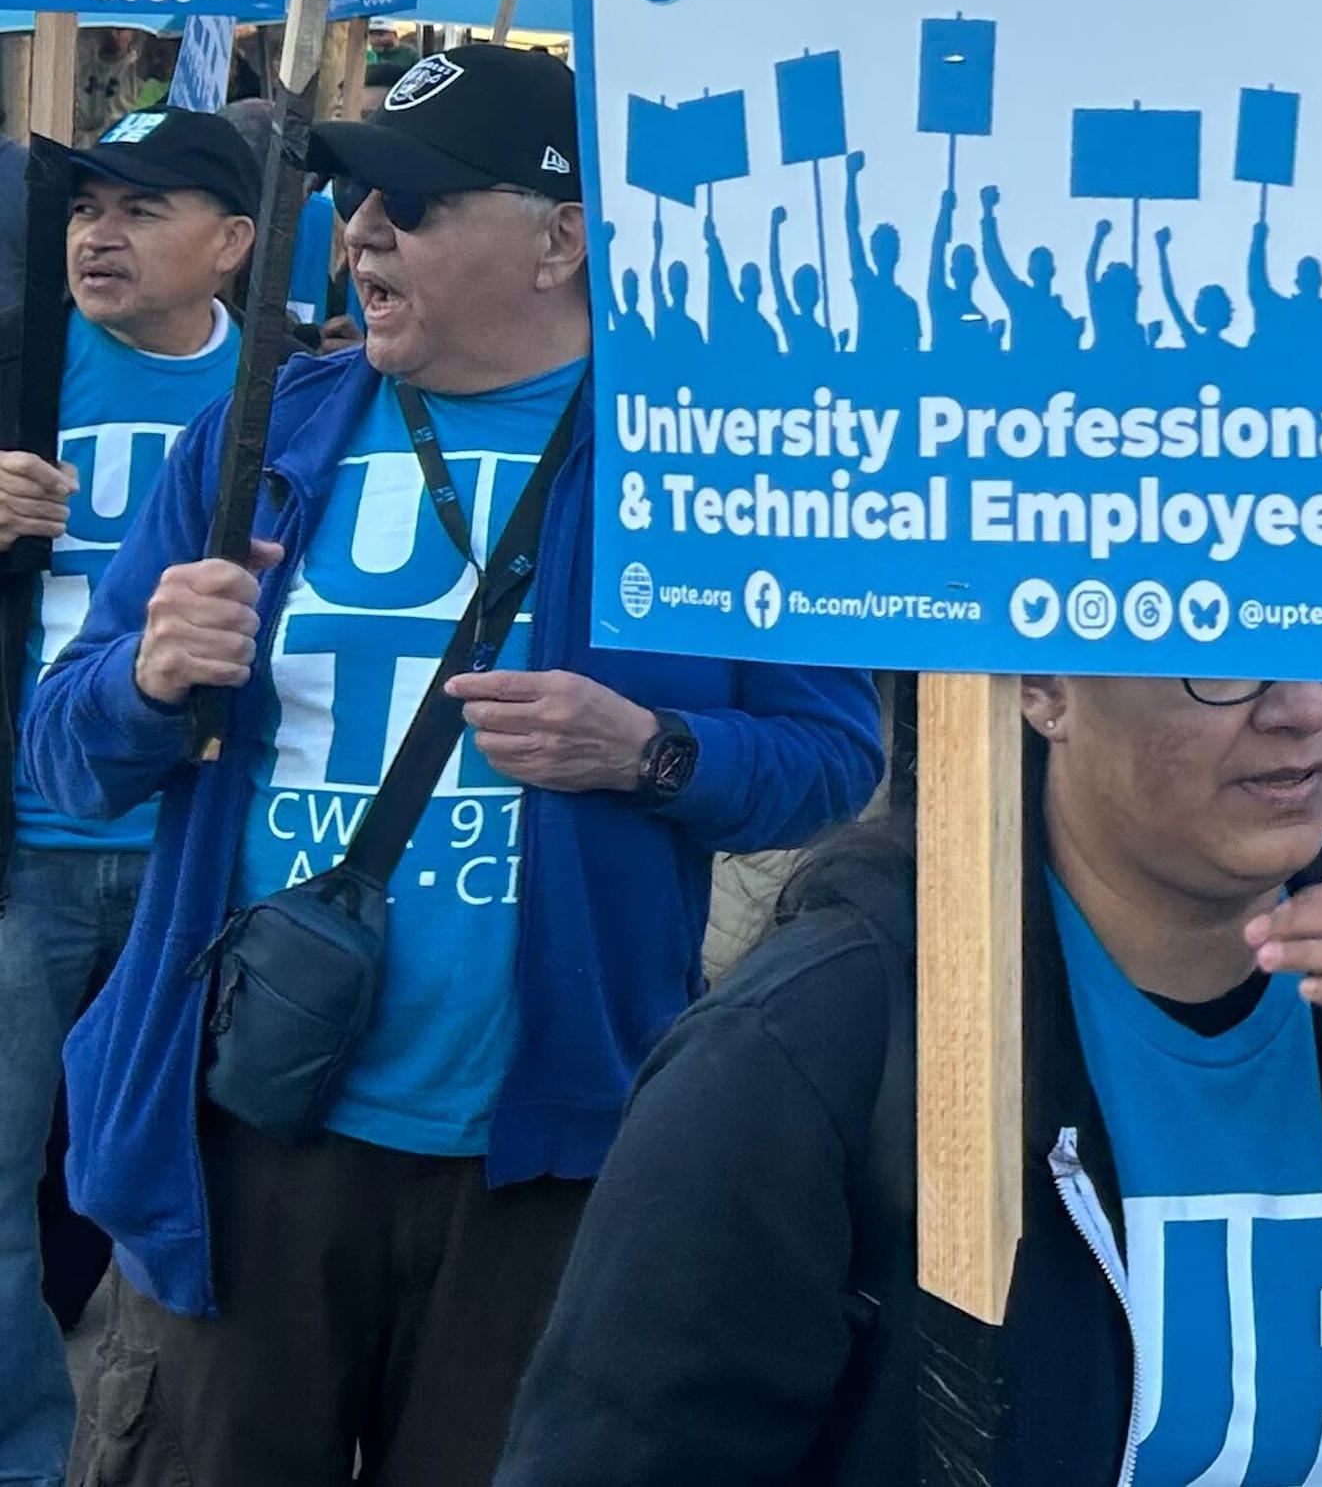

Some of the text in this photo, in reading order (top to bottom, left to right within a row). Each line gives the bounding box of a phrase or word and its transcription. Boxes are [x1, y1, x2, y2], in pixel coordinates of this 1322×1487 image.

[616, 386, 900, 473] University
[619, 472, 653, 531] &
[663, 473, 948, 543] Technical
[658, 582, 731, 614] upte.org
[787, 589, 982, 623] fb.com/UPTEcwa
[451, 799, 521, 848] 91
